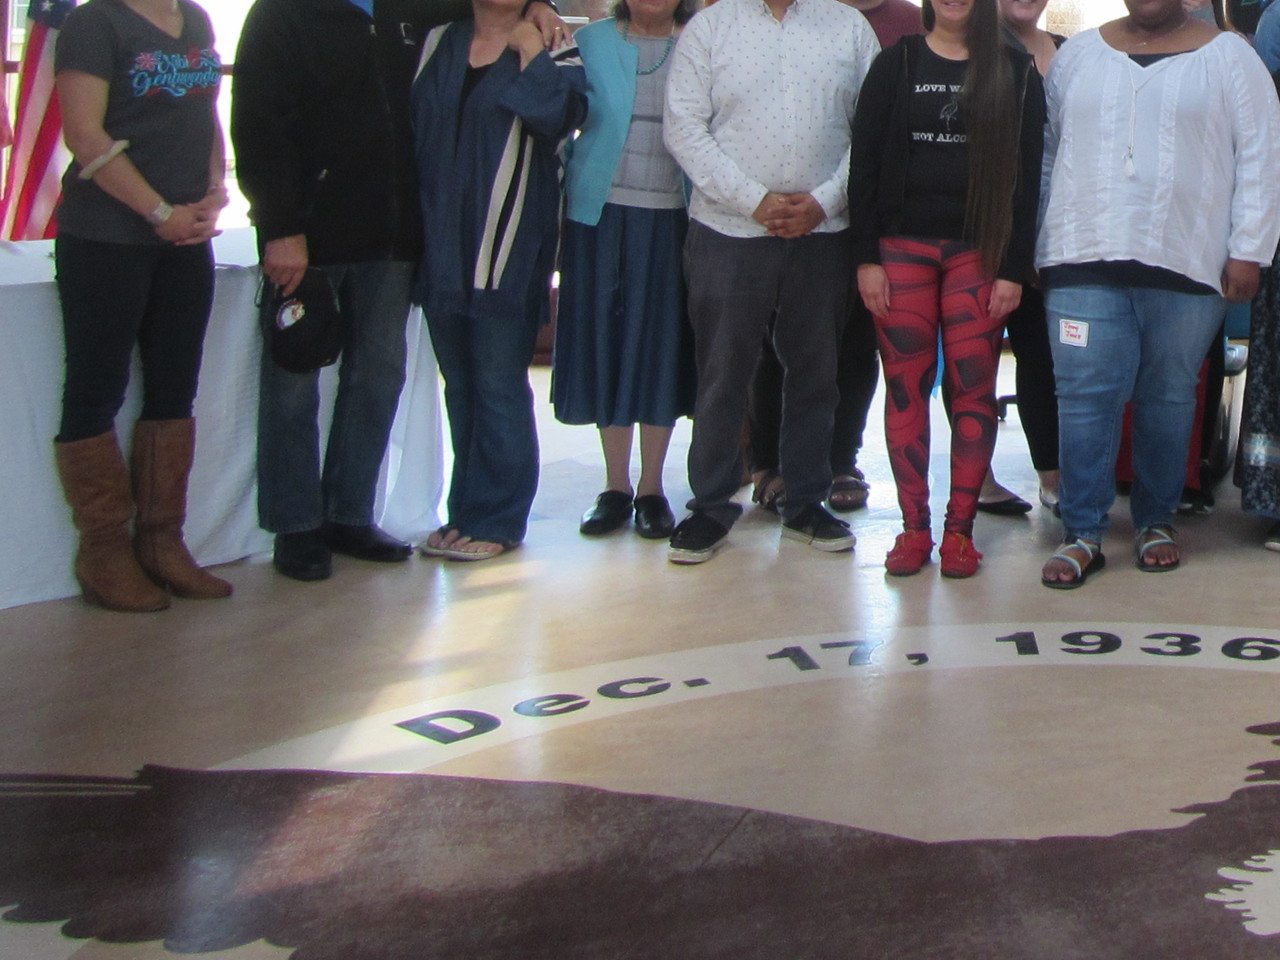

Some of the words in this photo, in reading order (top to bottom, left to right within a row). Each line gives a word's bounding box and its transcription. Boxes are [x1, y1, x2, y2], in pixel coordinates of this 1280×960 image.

[915, 84, 946, 92] LOVE
[912, 132, 934, 141] NOT
[936, 133, 967, 142] ALCO
[394, 675, 710, 746] Dec.
[765, 639, 930, 670] 17,
